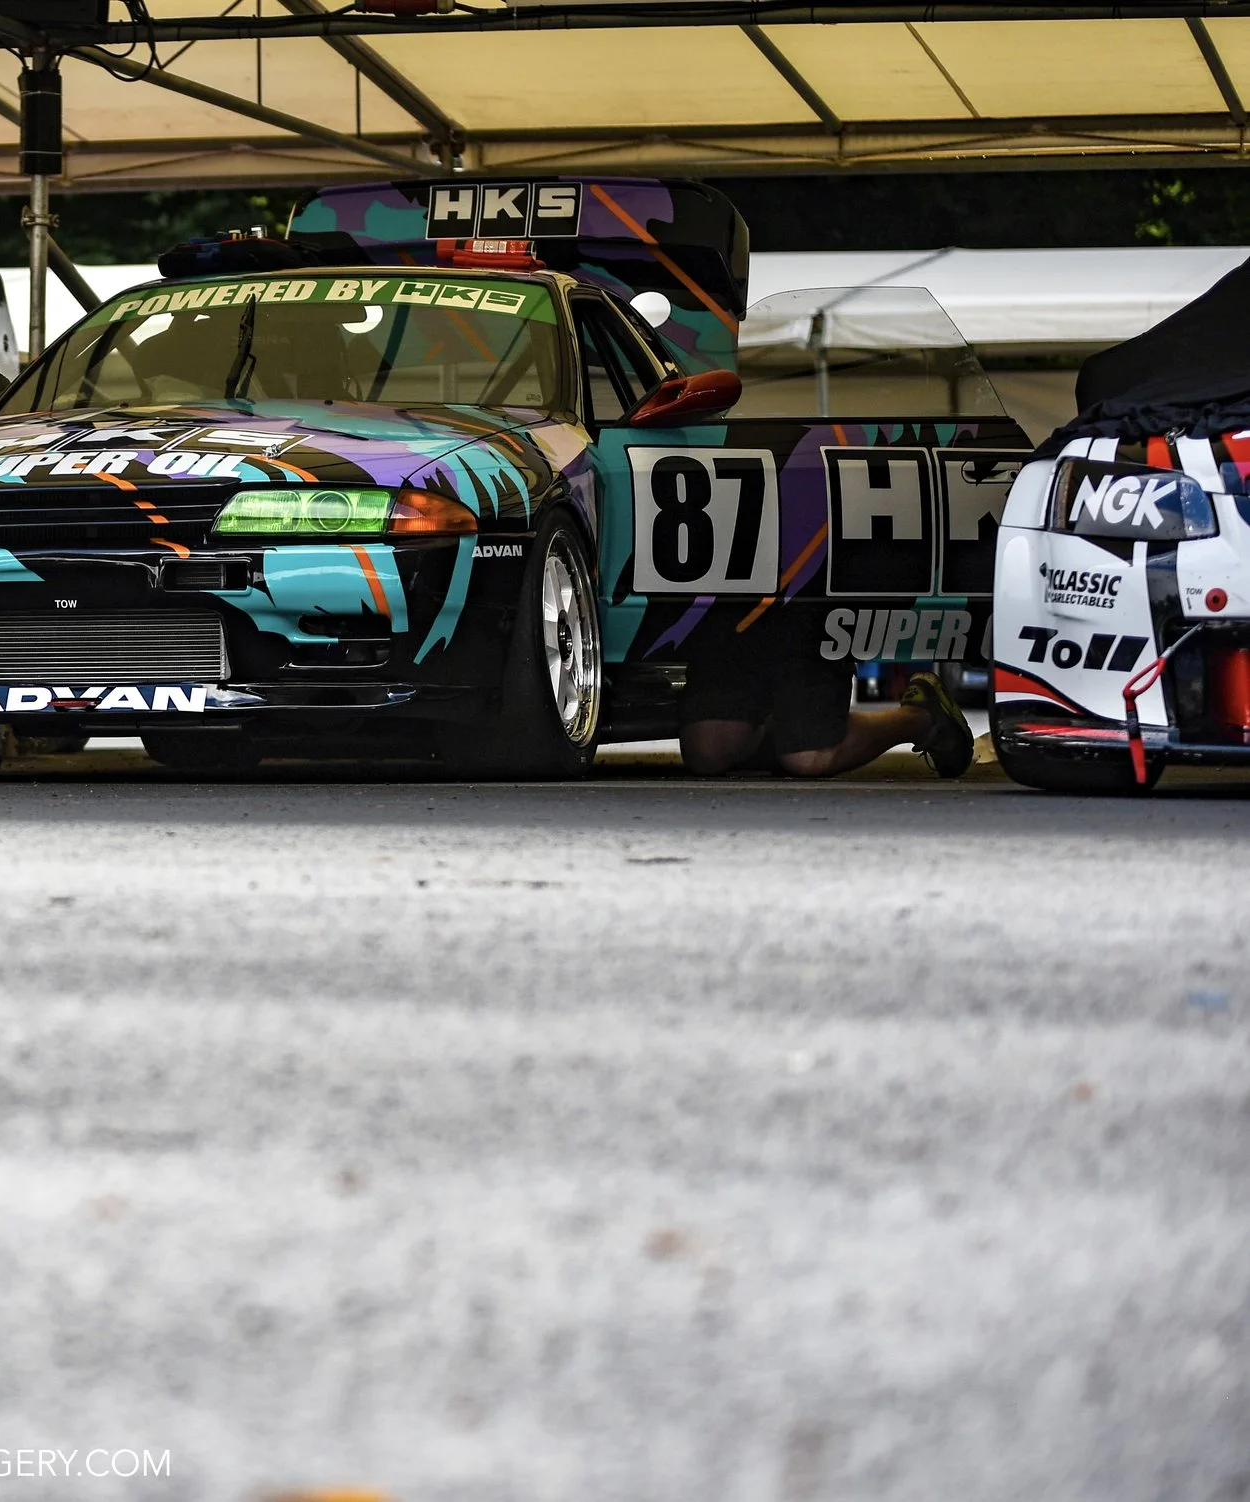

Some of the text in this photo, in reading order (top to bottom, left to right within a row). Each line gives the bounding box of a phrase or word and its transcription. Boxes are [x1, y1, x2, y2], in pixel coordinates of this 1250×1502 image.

[434, 187, 577, 220] HKS
[109, 279, 526, 322] POWERED BY HKS
[146, 452, 247, 477] OIL
[651, 456, 766, 583] 87
[1069, 474, 1177, 530] NGK
[471, 544, 523, 558] ADVAN
[55, 599, 78, 609] TOW
[1185, 587, 1203, 596] TOW
[820, 608, 972, 661] SUPER
[1018, 626, 1149, 672] Toll
